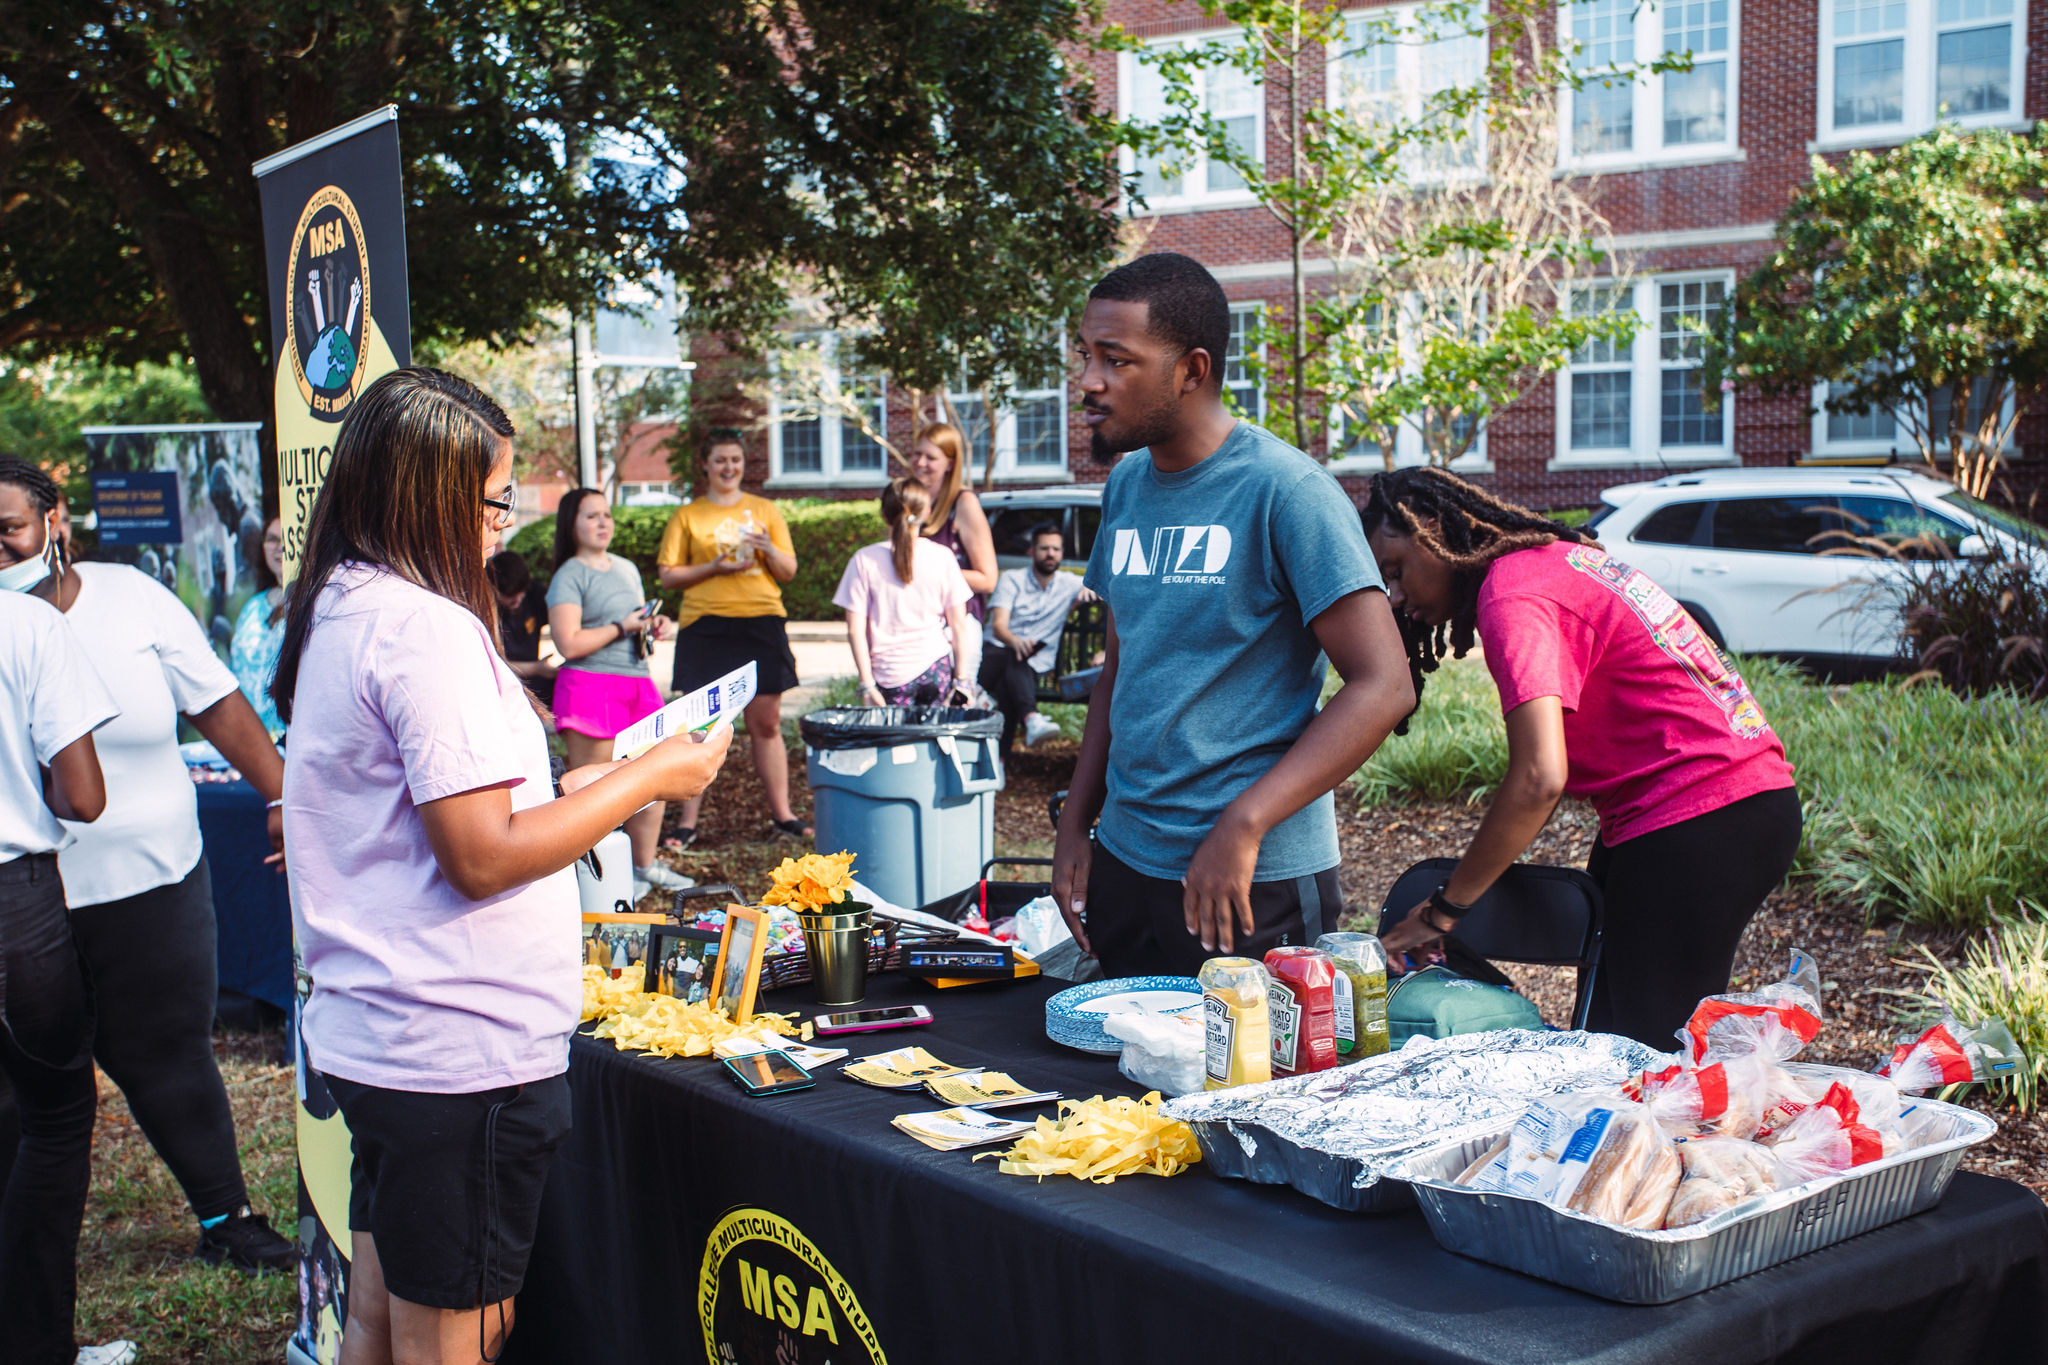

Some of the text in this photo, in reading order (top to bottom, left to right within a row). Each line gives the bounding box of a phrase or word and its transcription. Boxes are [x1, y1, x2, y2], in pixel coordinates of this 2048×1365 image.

[301, 191, 346, 232] MULTICULTURAL
[345, 203, 367, 259] STUDENT
[309, 218, 346, 259] MSA
[313, 393, 332, 414] EST.
[296, 487, 321, 523] ST
[1111, 524, 1232, 576] UNITED
[1161, 575, 1226, 585] SEE YOU AT THE POLE
[1269, 1019, 1290, 1032] ETCHUP
[1533, 1125, 1546, 1136] 110
[1794, 1190, 1850, 1233] BEEF
[703, 1242, 722, 1332] COLLEGE
[717, 1217, 834, 1284] MULTICULTURAL
[738, 1258, 839, 1346] MSA
